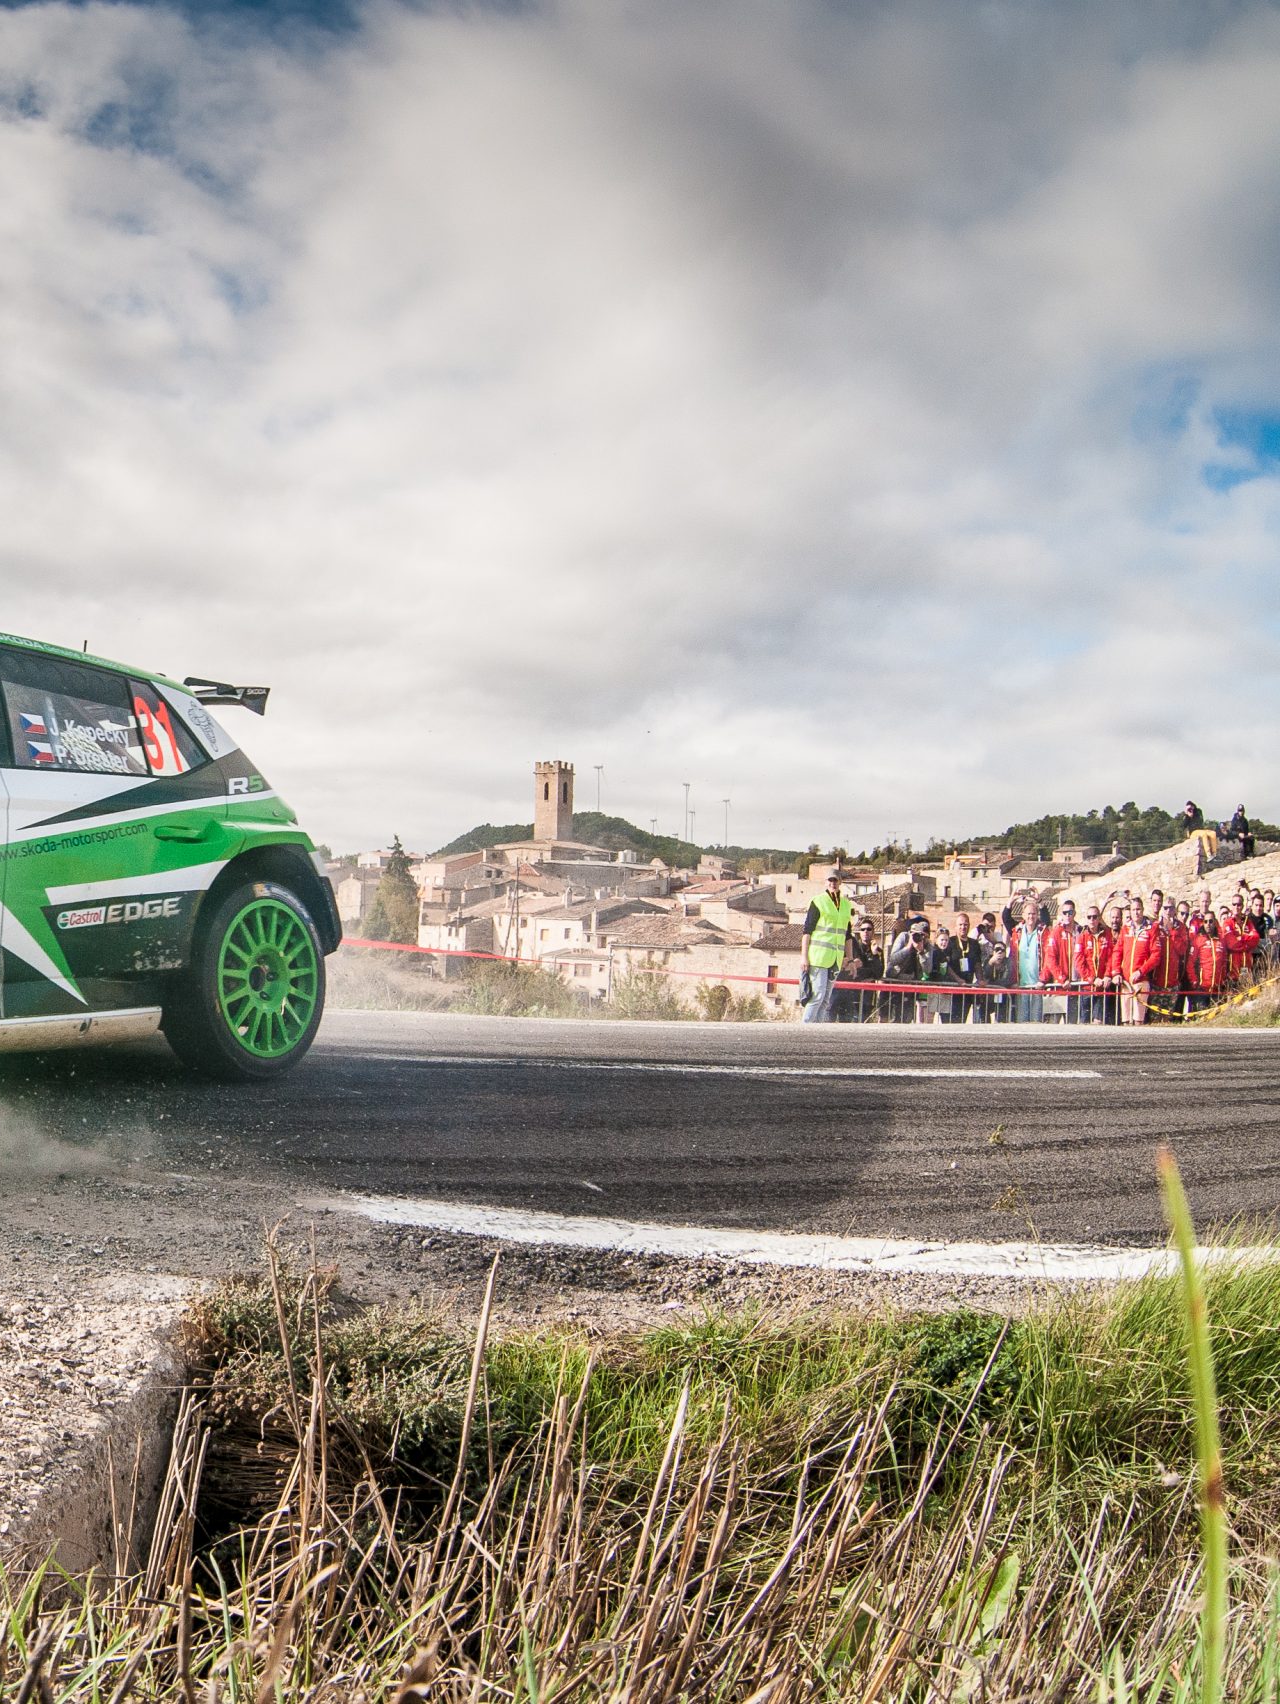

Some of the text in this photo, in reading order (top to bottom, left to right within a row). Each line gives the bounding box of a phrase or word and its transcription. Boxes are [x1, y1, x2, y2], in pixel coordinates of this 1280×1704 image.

[133, 696, 183, 772] 31
[228, 774, 265, 795] R5
[68, 896, 182, 926] Castrol EDGE
